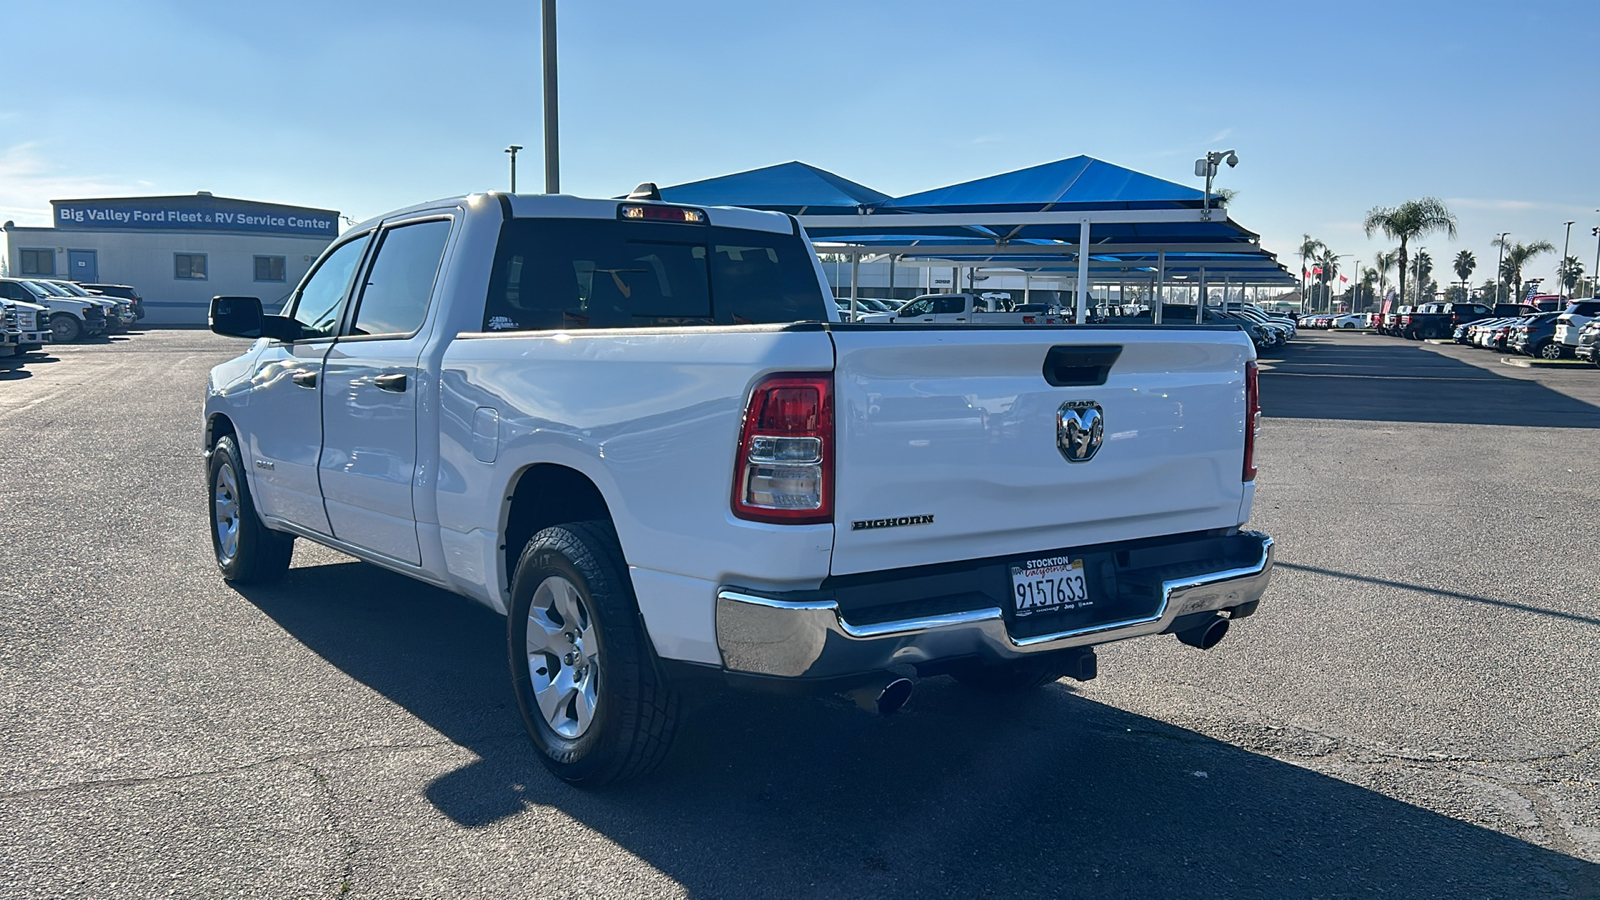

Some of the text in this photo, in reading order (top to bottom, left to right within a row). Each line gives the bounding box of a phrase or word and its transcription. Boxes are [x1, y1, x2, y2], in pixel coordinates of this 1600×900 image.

[60, 208, 331, 229] Big Valley Ford Fleet & RV Service Center
[1067, 401, 1098, 409] RAM
[851, 514, 934, 531] BIGHORN
[1026, 556, 1069, 569] STOCKTON
[1024, 565, 1072, 579] California
[1016, 576, 1085, 608] 91576S3
